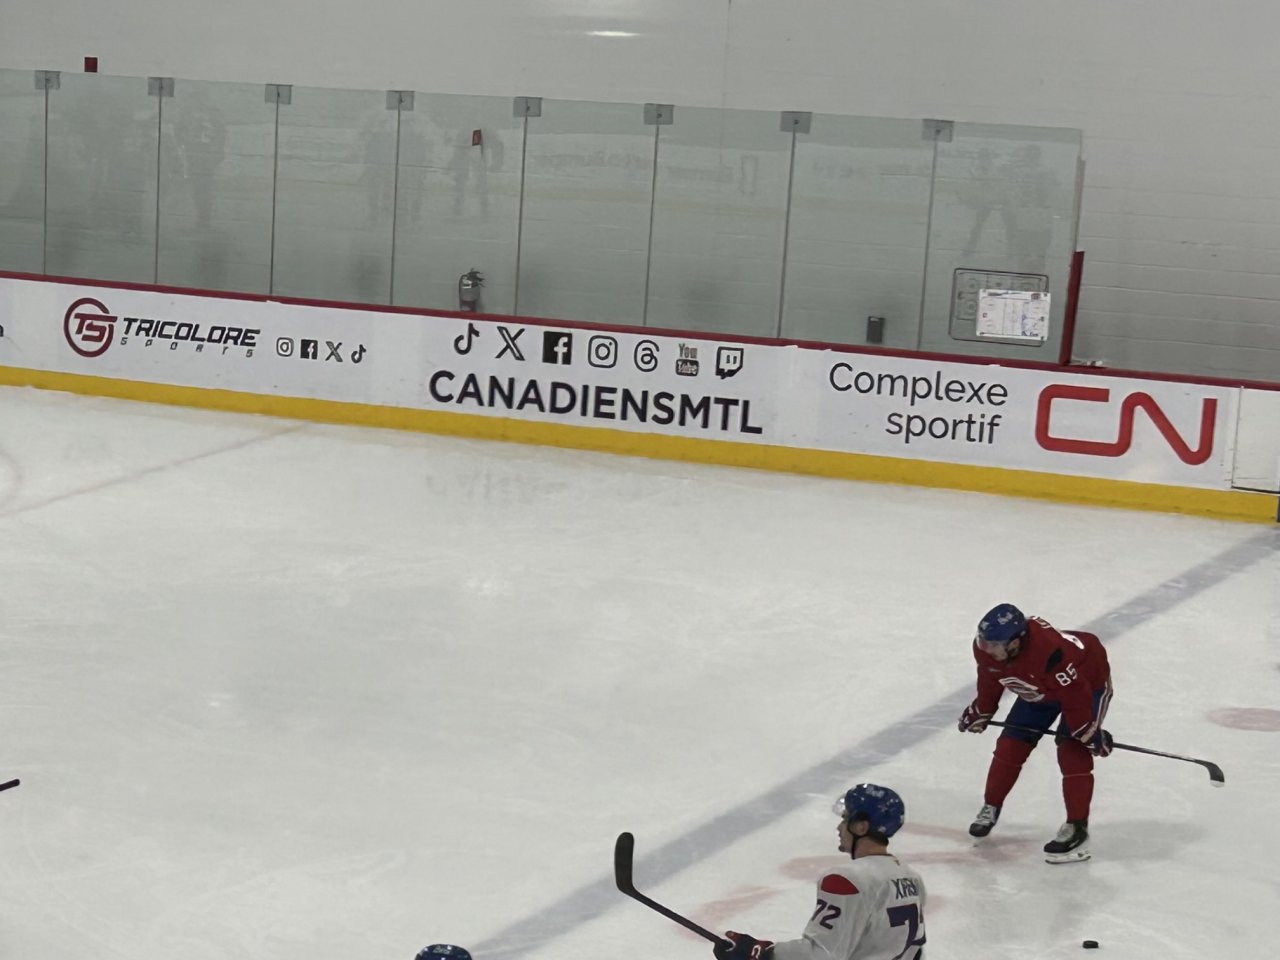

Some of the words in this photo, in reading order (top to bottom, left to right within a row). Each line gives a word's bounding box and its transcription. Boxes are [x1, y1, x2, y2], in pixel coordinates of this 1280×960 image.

[122, 317, 261, 347] TRICOLORE
[829, 362, 1008, 407] Complexe
[429, 370, 763, 435] CANADIENSMTL
[885, 411, 1003, 445] sportif
[1035, 384, 1218, 466] CN
[1055, 662, 1078, 687] 85
[810, 898, 842, 931] 72
